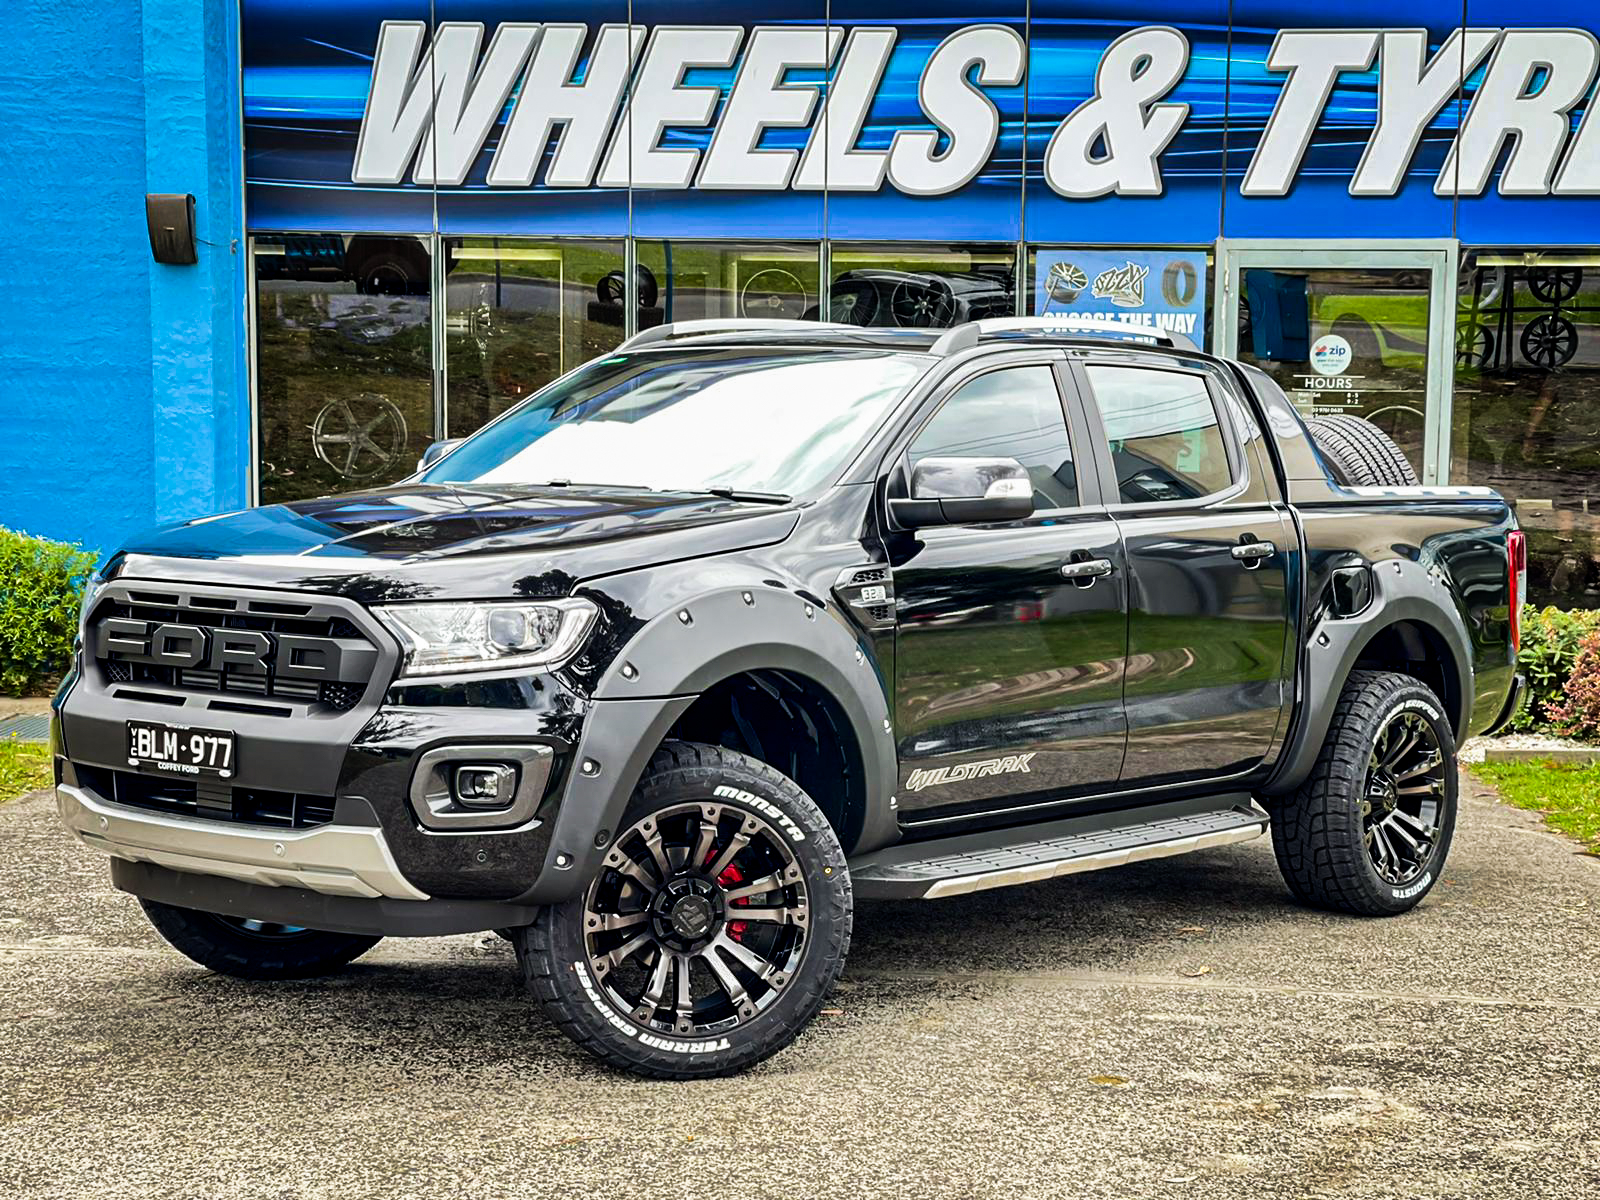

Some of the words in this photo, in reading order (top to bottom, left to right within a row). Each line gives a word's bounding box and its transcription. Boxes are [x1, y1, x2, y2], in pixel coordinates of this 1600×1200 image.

[352, 20, 1025, 196] WHEELS
[1044, 26, 1190, 198] &
[1155, 314, 1196, 334] WAY
[1329, 345, 1346, 356] zip
[1304, 378, 1353, 389] HOURS
[96, 618, 346, 683] FORD
[130, 727, 138, 756] VIC
[157, 761, 181, 771] COFFEY
[181, 764, 200, 774] FORD
[905, 752, 1036, 792] WILDTRAK
[713, 785, 806, 842] MONSTA
[574, 961, 638, 1037] GRIPPER
[638, 1033, 732, 1054] TERRAIN
